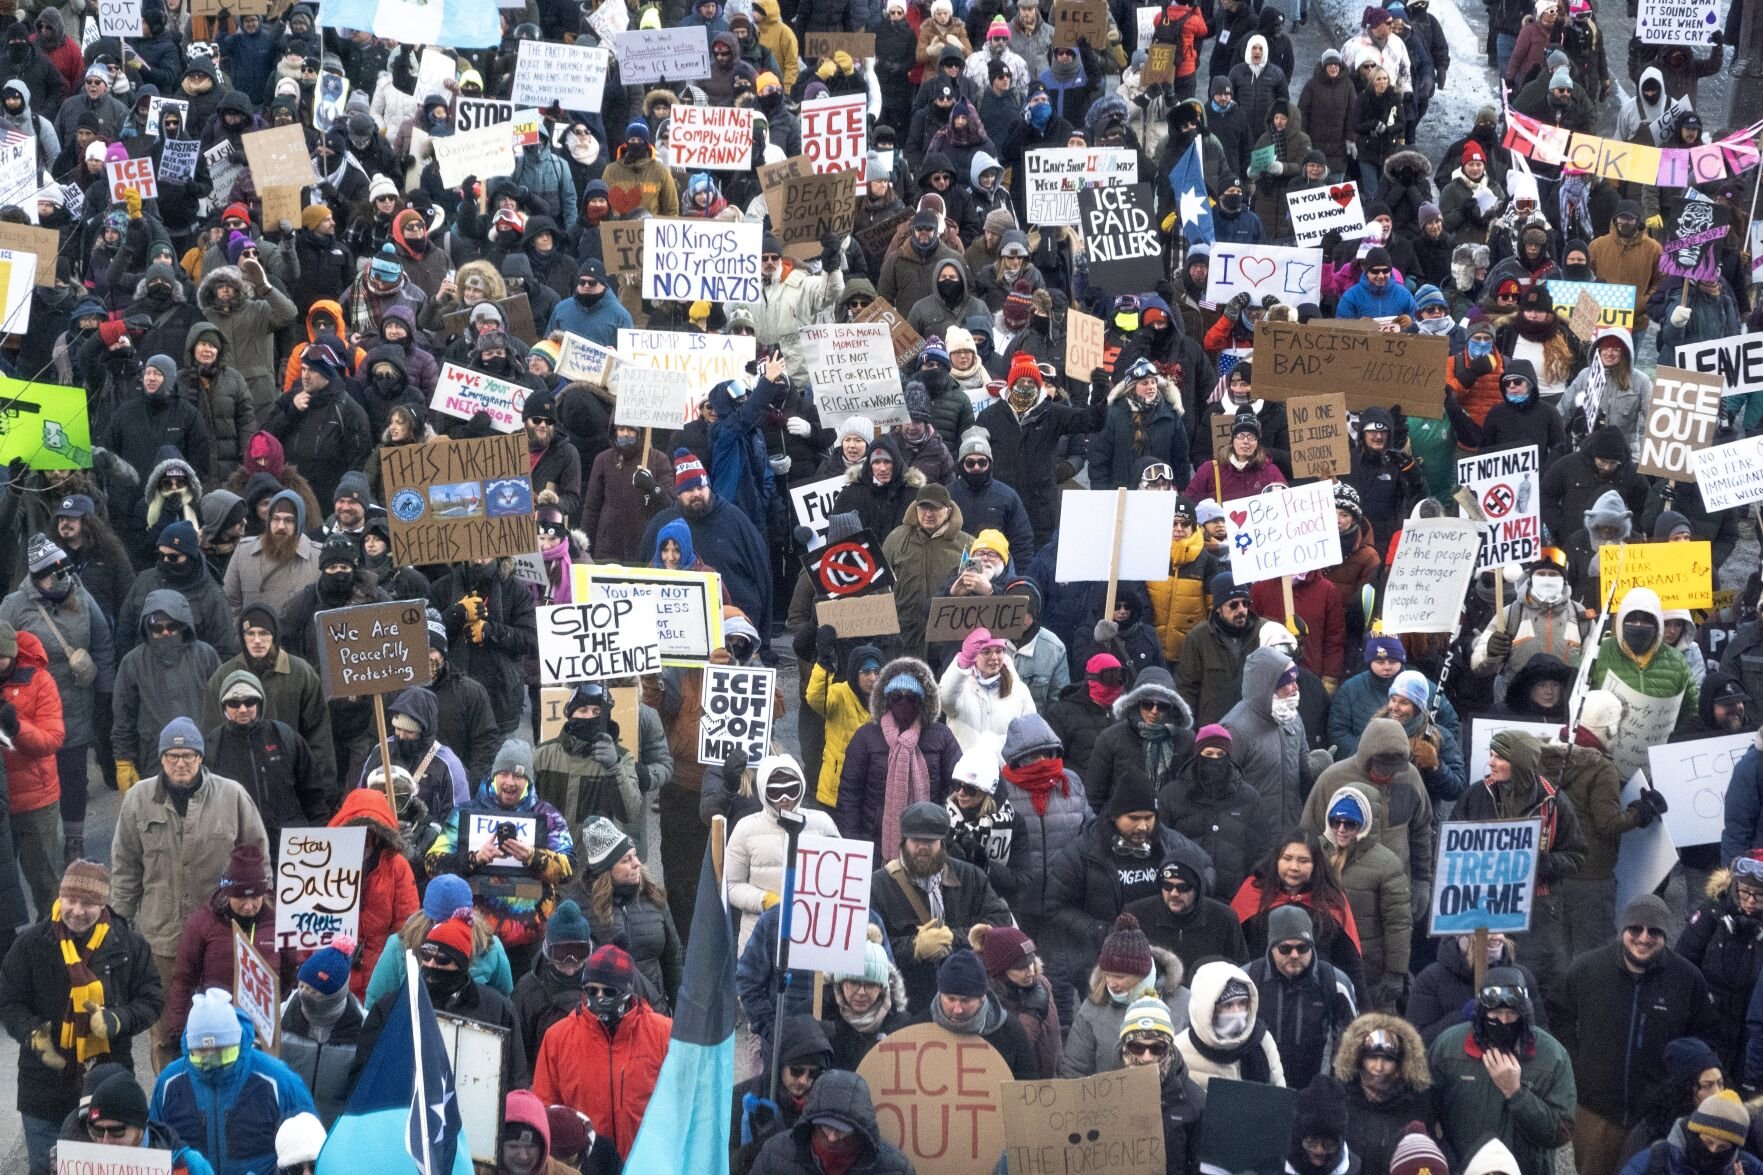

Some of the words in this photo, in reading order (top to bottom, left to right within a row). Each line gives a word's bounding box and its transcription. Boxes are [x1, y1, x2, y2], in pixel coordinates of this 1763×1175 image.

[100, 2, 135, 16] OUT
[1061, 10, 1094, 23] ICE
[1646, 6, 1655, 15] IT
[1660, 7, 1698, 18] SOUNDS
[104, 18, 139, 31] NOW
[1646, 29, 1679, 40] DOVES
[1652, 18, 1672, 27] LIKE
[1677, 19, 1703, 28] WHEN
[652, 60, 667, 73] ICE
[459, 101, 513, 132] STOP
[673, 108, 697, 125] WE
[702, 108, 725, 127] Will
[728, 108, 753, 128] Not
[802, 107, 864, 139] ICE
[1657, 103, 1681, 131] ICE
[166, 141, 200, 153] JUSTICE
[671, 126, 720, 145] Comply
[724, 129, 753, 147] With
[804, 133, 864, 161] OUT
[671, 144, 749, 164] TYRANNY
[1028, 156, 1041, 174] U
[114, 160, 151, 181] ICE
[786, 177, 856, 205] DEATH
[1093, 187, 1136, 211] ICE:
[1289, 197, 1299, 206] IN
[1301, 192, 1327, 204] YOUR
[783, 196, 853, 222] SQUADS
[1296, 212, 1316, 223] YOU
[1318, 208, 1346, 220] KNOW
[783, 223, 815, 243] OUT
[1090, 208, 1149, 235] PAID
[656, 224, 677, 248] NO
[682, 223, 738, 258] Kings
[1087, 230, 1162, 263] KILLERS
[1297, 230, 1318, 242] THIS
[656, 251, 678, 272] NO
[682, 251, 758, 276] Tyrants
[1215, 253, 1235, 286] I
[653, 272, 692, 299] NO
[700, 275, 760, 303] NAZIS
[629, 333, 680, 350] TRUMP
[688, 333, 706, 350] IS
[722, 338, 734, 351] A
[805, 330, 829, 341] THIS
[835, 329, 844, 339] IS
[845, 329, 854, 338] A
[856, 329, 884, 338] MORAL
[1072, 318, 1100, 347] ICE
[825, 355, 835, 366] IT
[837, 354, 846, 364] IS
[850, 352, 869, 363] NOT
[1069, 344, 1101, 369] OUT
[1383, 339, 1407, 358] IS
[624, 368, 648, 381] NOT
[653, 371, 688, 384] EVEN
[814, 369, 842, 385] LEFT
[844, 372, 857, 381] OR
[857, 366, 893, 382] RIGHT
[624, 385, 670, 399] HEATED
[844, 384, 855, 395] IT
[857, 383, 867, 394] IS
[1651, 378, 1722, 416] ICE
[820, 395, 860, 412] RIGHT
[1292, 407, 1309, 425] NO
[1315, 405, 1335, 420] ONE
[1290, 429, 1304, 445] IS
[1307, 423, 1343, 442] ILLEGAL
[1650, 407, 1718, 443] OUT
[383, 443, 441, 487] THIS
[447, 433, 529, 482] MACHINE
[1294, 450, 1307, 463] ON
[1308, 445, 1333, 462] STOLEN
[1698, 451, 1714, 465] NO
[1460, 461, 1475, 484] IF
[1477, 456, 1501, 481] NOT
[1701, 466, 1718, 479] NO
[1724, 458, 1755, 474] FEAR
[1248, 499, 1279, 525] Be
[1709, 494, 1729, 509] ARE
[1285, 512, 1327, 540] Good
[1404, 529, 1424, 544] The
[1429, 530, 1469, 545] power
[1503, 516, 1537, 542] NAZI
[393, 522, 461, 566] DEFEATS
[463, 516, 539, 559] TYRANNY
[1255, 550, 1282, 572] ICE
[1293, 539, 1329, 565] OUT
[1397, 550, 1409, 560] of
[1413, 549, 1430, 560] the
[1434, 548, 1472, 567] people
[1388, 581, 1409, 592] than
[1415, 581, 1431, 592] the
[1396, 568, 1404, 577] is
[1409, 568, 1458, 583] stronger
[660, 588, 689, 599] NOT
[1391, 594, 1420, 610] people
[1423, 594, 1434, 605] in
[550, 600, 633, 636] STOP
[933, 603, 989, 631] FUCK
[990, 603, 1025, 630] ICE
[1399, 610, 1434, 624] power
[329, 622, 359, 643] We
[371, 619, 400, 639] Are
[573, 631, 620, 654] THE
[340, 641, 409, 665] Peacefully
[545, 643, 661, 681] VIOLENCE
[343, 664, 415, 685] Protesting
[711, 671, 767, 697] ICE
[710, 695, 767, 719] OUT
[727, 717, 766, 741] OF
[1446, 826, 1533, 851] DONTCHA
[286, 836, 332, 869] Stay
[792, 848, 868, 903] ICE
[1445, 850, 1531, 885] TREAD
[280, 861, 361, 914] Salty
[1440, 884, 1481, 916] ON
[1487, 882, 1526, 914] ME
[788, 898, 867, 952] OUT
[878, 1041, 990, 1098] ICE
[1021, 1083, 1057, 1108] DO
[1082, 1076, 1128, 1103] NOT
[874, 1102, 997, 1161] OUT
[1009, 1145, 1055, 1175] THE
[1063, 1135, 1163, 1175] FOREIGNER
